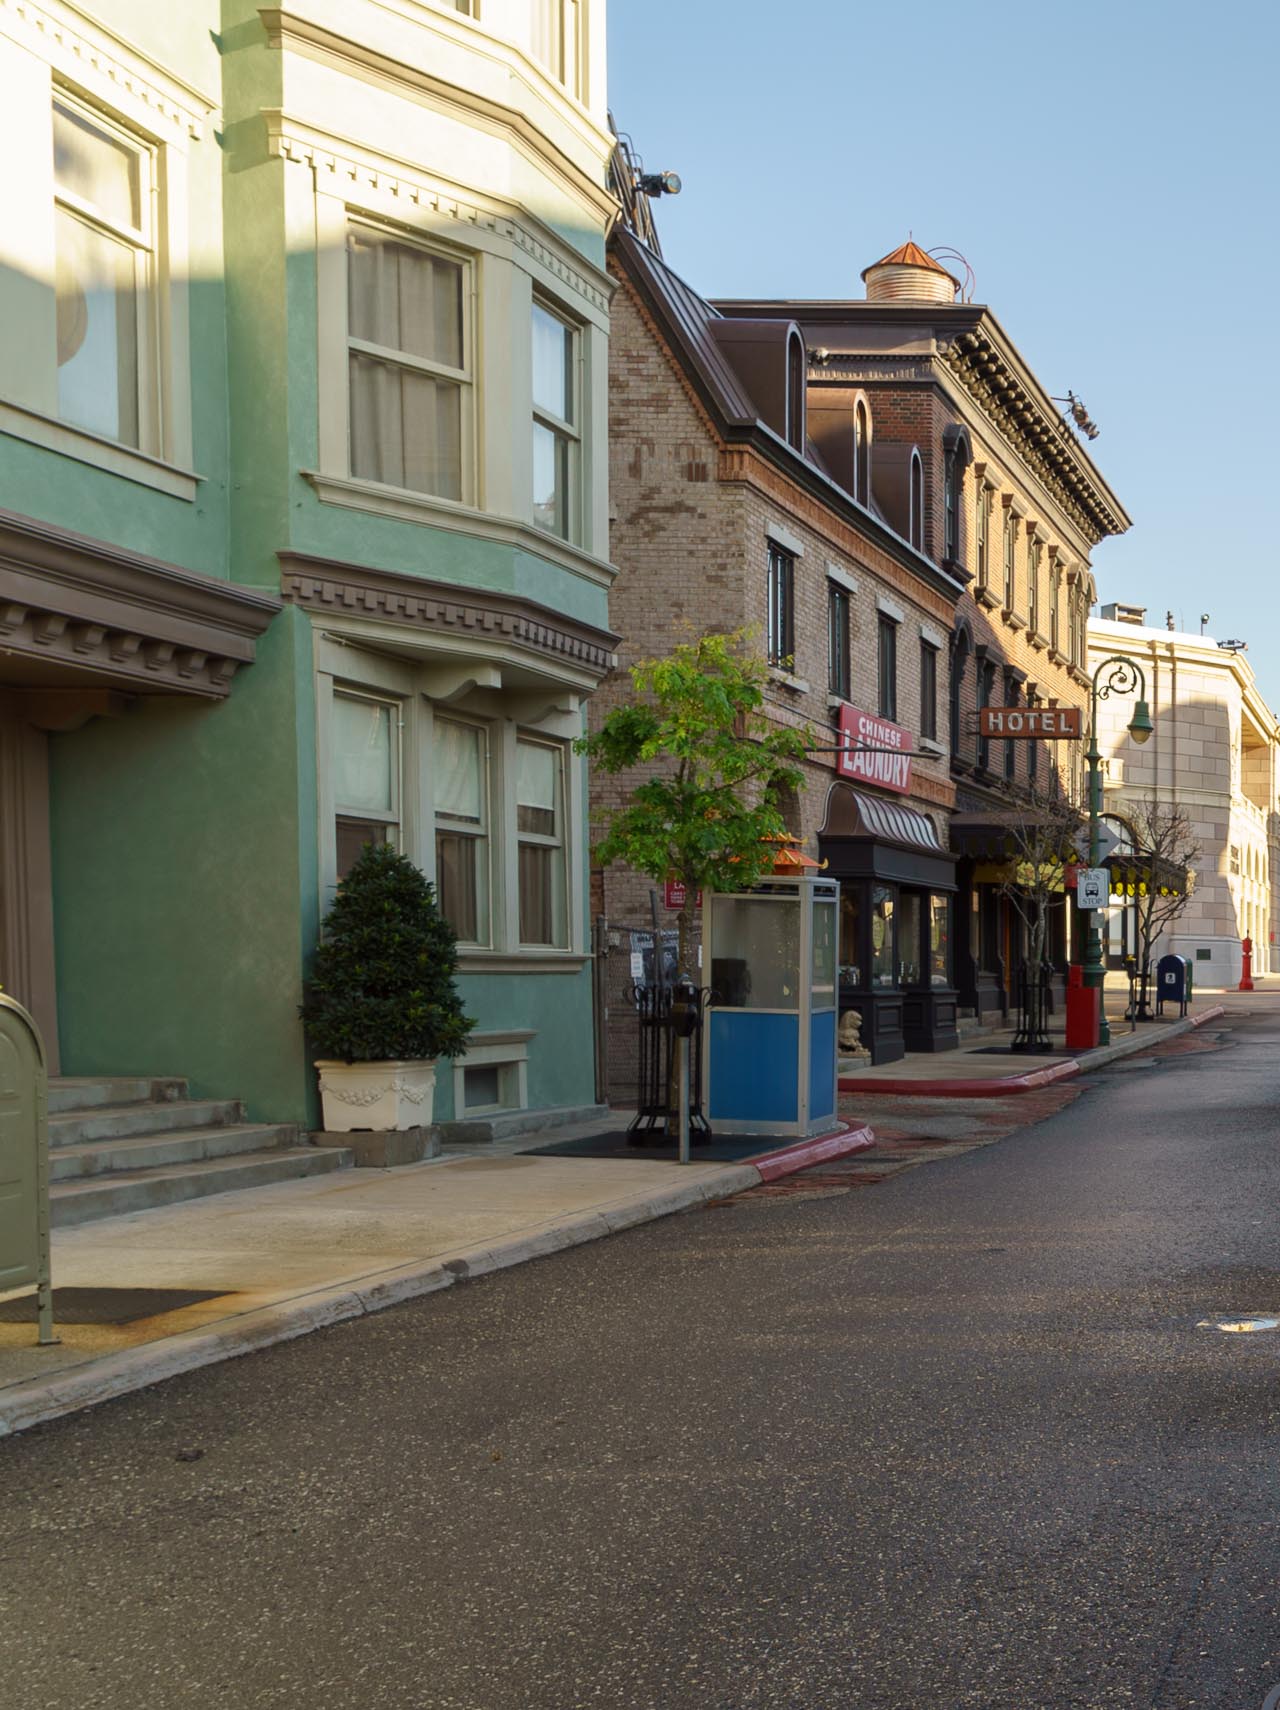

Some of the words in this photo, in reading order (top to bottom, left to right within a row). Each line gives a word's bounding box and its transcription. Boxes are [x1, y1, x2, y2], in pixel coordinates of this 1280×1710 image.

[858, 716, 902, 748] CHINESE
[988, 712, 1073, 732] HOTEL
[843, 728, 911, 788] LAUNDRY
[1082, 897, 1103, 905] STOP
